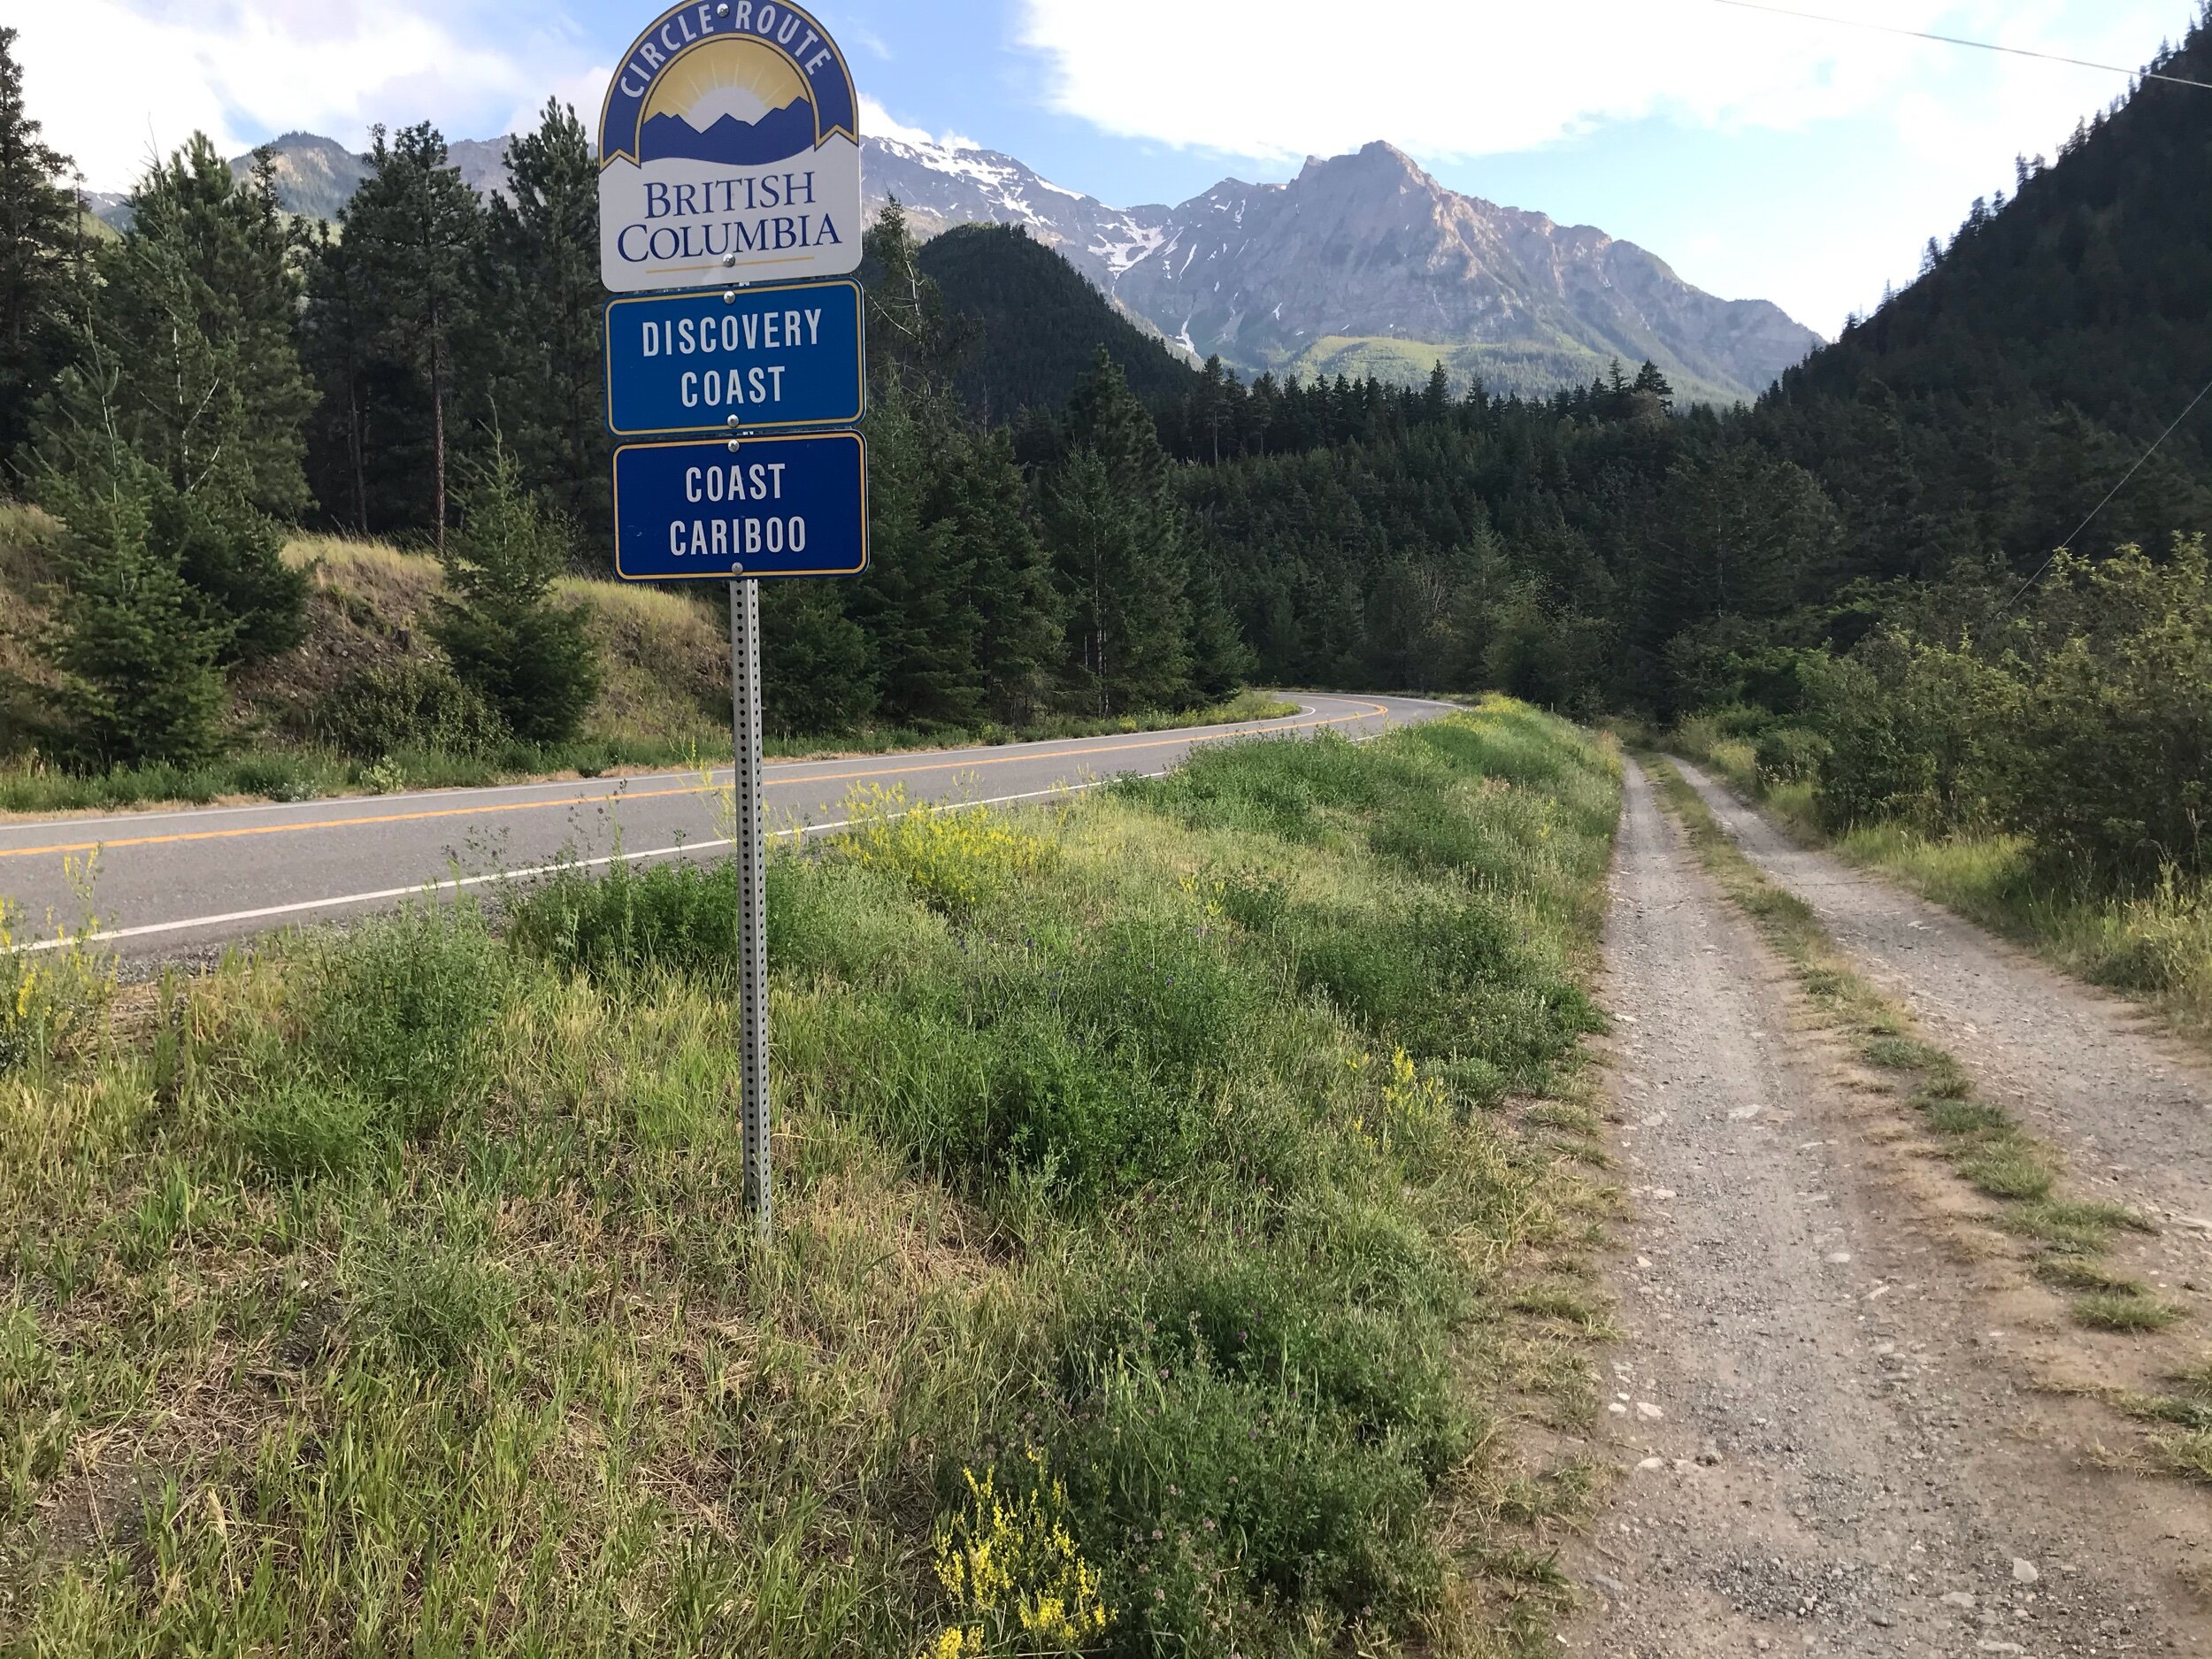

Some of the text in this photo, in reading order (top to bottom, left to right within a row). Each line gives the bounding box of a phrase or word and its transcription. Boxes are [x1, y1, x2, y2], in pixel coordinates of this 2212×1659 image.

[620, 0, 833, 98] CIRCLE ROUTE
[643, 172, 816, 219] BRITISH
[618, 213, 842, 263] COLUMBIA
[642, 309, 821, 357] DISCOVERY
[681, 365, 786, 408] COAST
[686, 463, 786, 503] COAST
[670, 516, 806, 557] CARIBOO
